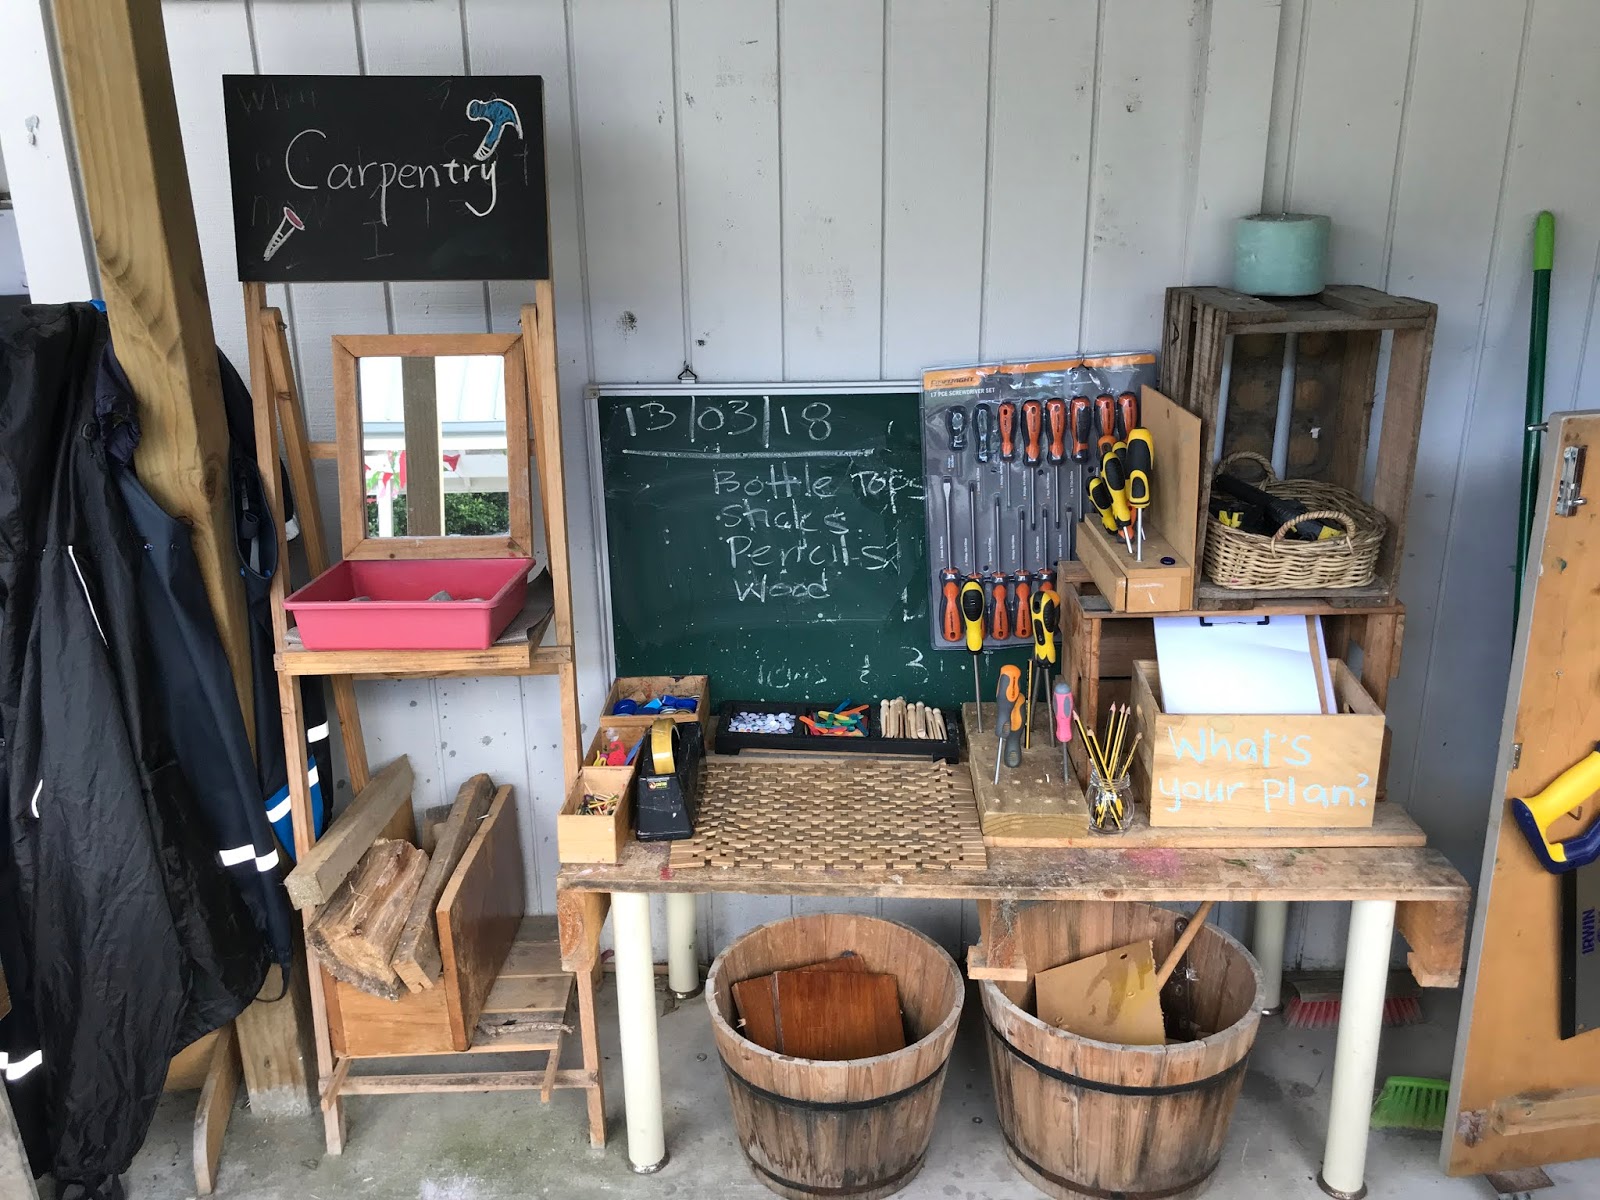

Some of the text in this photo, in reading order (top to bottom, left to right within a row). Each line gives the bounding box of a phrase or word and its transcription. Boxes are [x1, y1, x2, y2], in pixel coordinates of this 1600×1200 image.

[285, 129, 498, 226] Carpentry
[949, 388, 985, 396] SCREWDRIVER
[713, 461, 836, 499] Bottle
[733, 568, 831, 602] Wood
[1158, 777, 1246, 812] your
[1582, 907, 1596, 955] IRWIN
